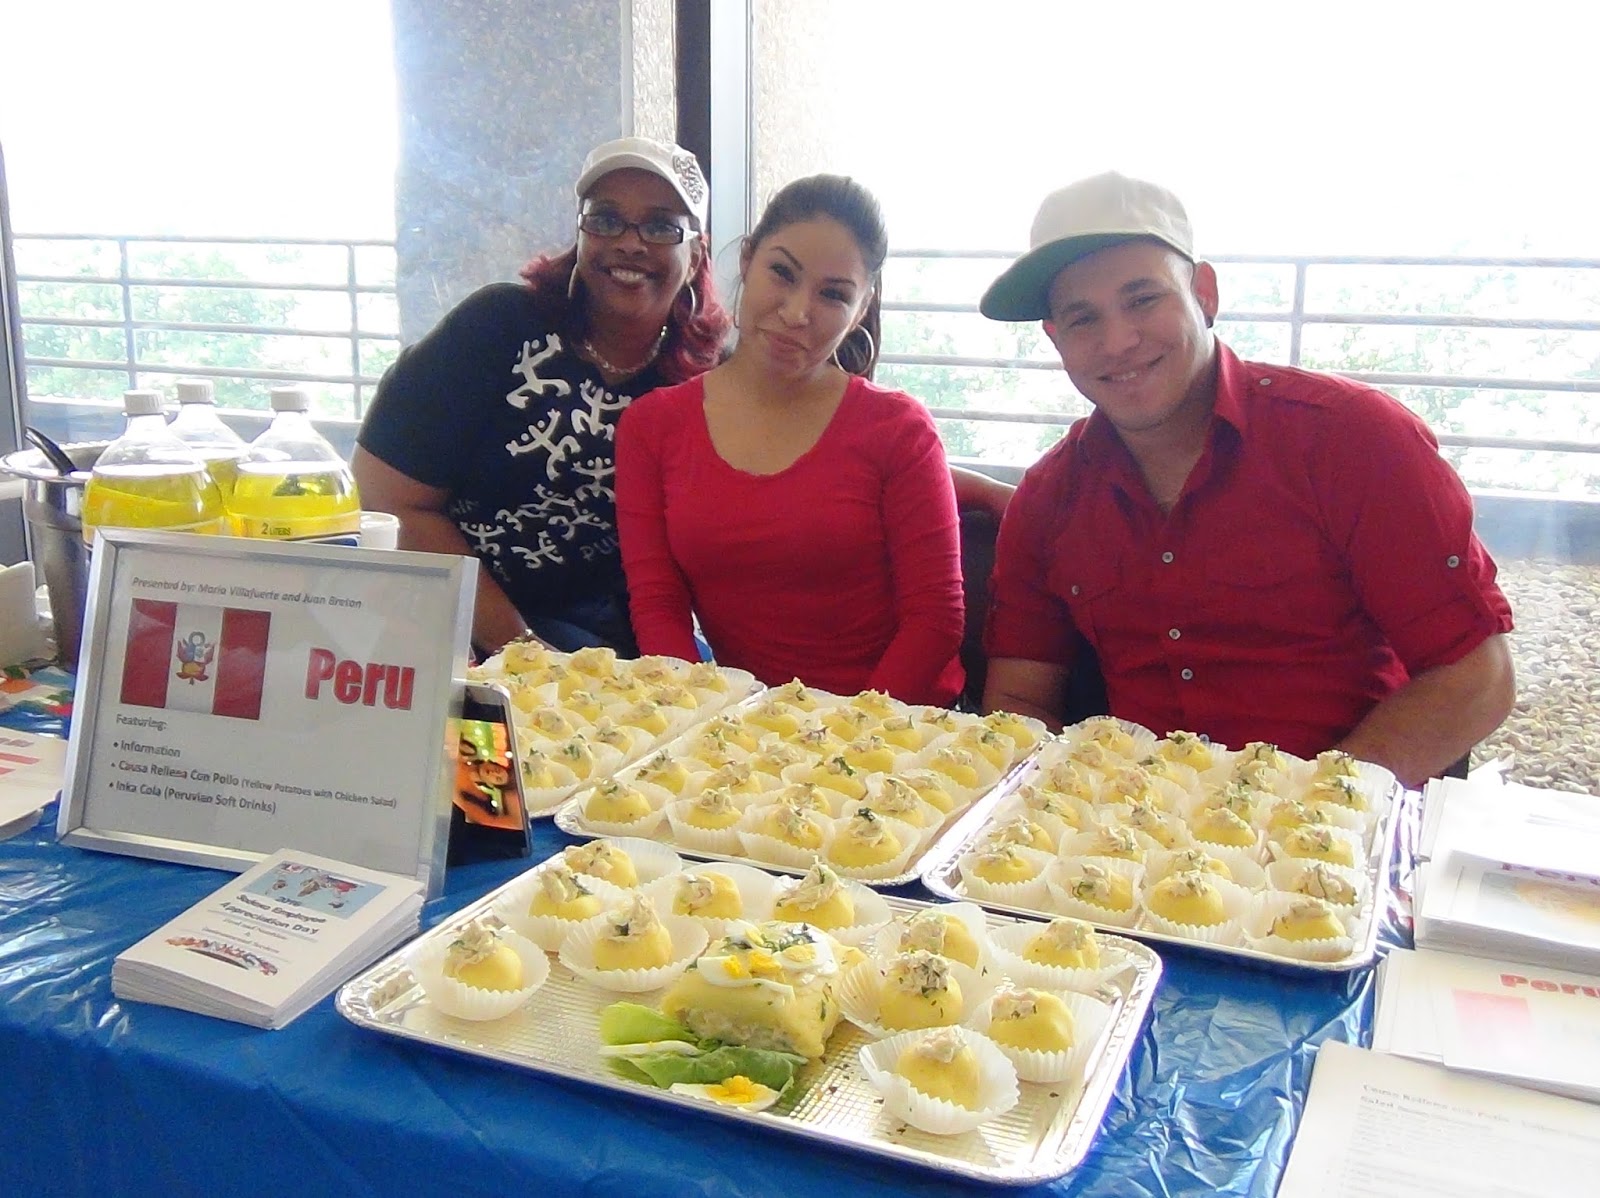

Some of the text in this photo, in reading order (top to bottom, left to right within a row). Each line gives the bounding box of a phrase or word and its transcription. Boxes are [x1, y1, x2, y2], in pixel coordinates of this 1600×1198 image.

[261, 522, 269, 535] 2
[131, 576, 179, 591] Presented
[180, 580, 195, 593] by:
[198, 584, 227, 596] Maria
[281, 591, 301, 603] and
[302, 593, 326, 604] Juan
[305, 648, 415, 710] Peru
[120, 740, 181, 758] Information
[116, 780, 277, 815] Inka Cola (Peruvian Soft Drinks)
[118, 760, 148, 773] Causa
[150, 764, 188, 779] Rellena
[190, 768, 211, 781] Con
[213, 772, 240, 787] Pollo
[274, 782, 312, 797] Potatoes
[313, 788, 332, 799] with
[334, 791, 368, 804] Chicken
[219, 901, 321, 936] Appreciation Day
[271, 906, 327, 923] Employee
